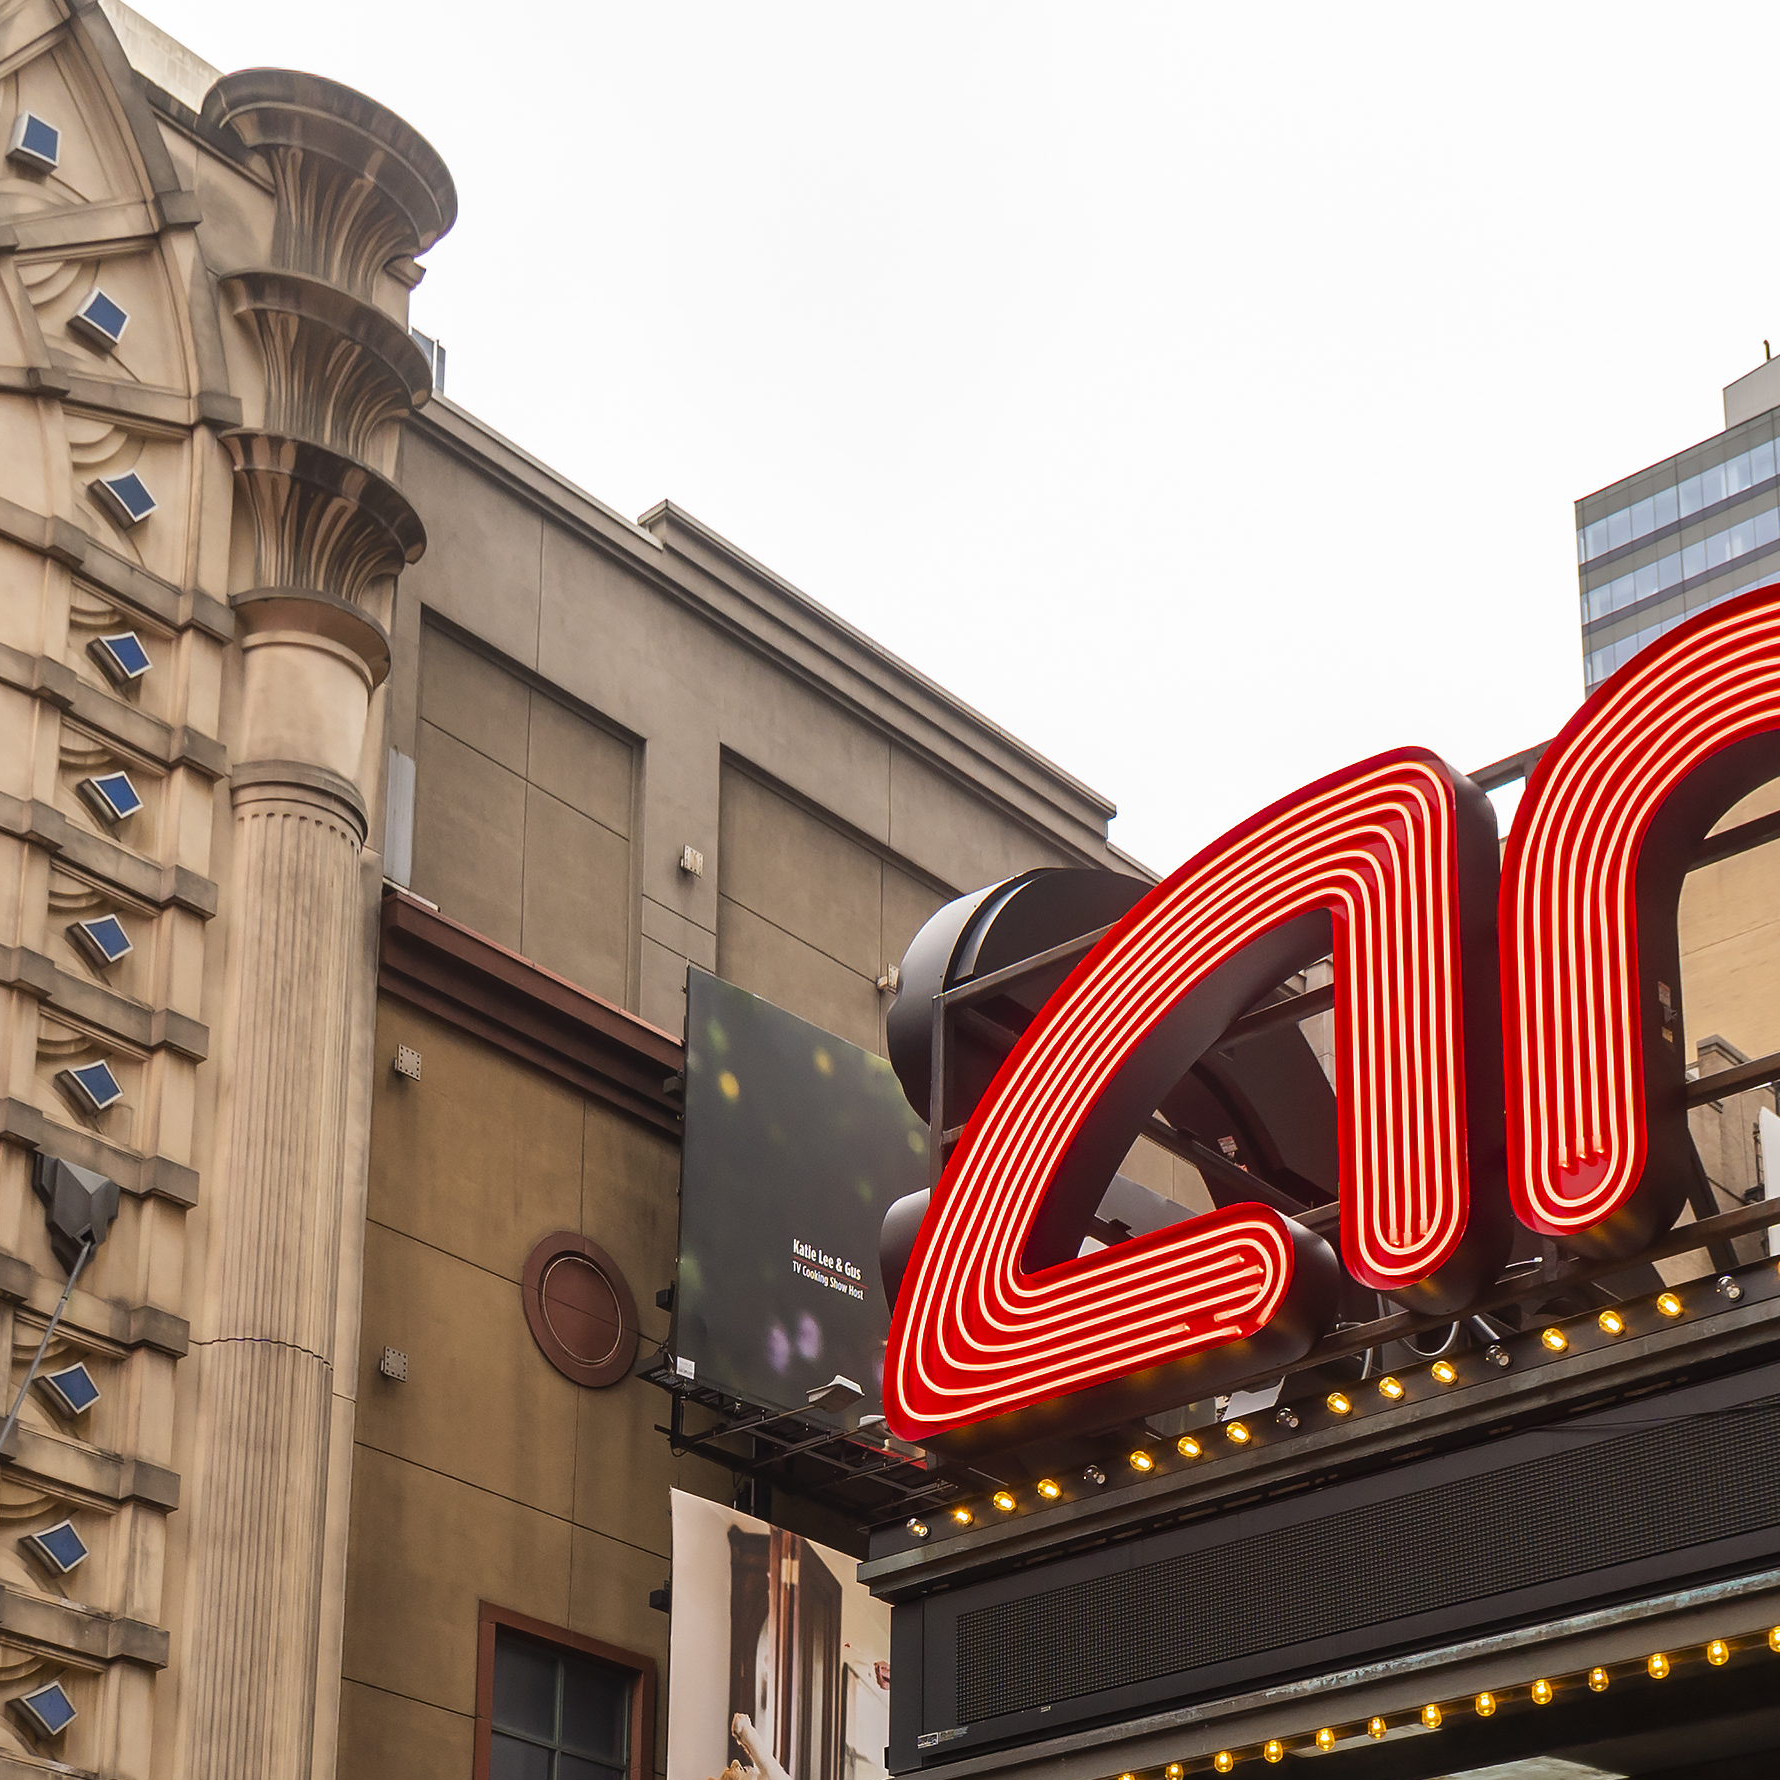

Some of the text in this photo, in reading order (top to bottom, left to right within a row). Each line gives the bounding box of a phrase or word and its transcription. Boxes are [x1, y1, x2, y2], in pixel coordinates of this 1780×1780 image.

[792, 1260, 864, 1301] TV Cooking Show Host
[793, 1238, 862, 1281] Katie Lee & Gus
